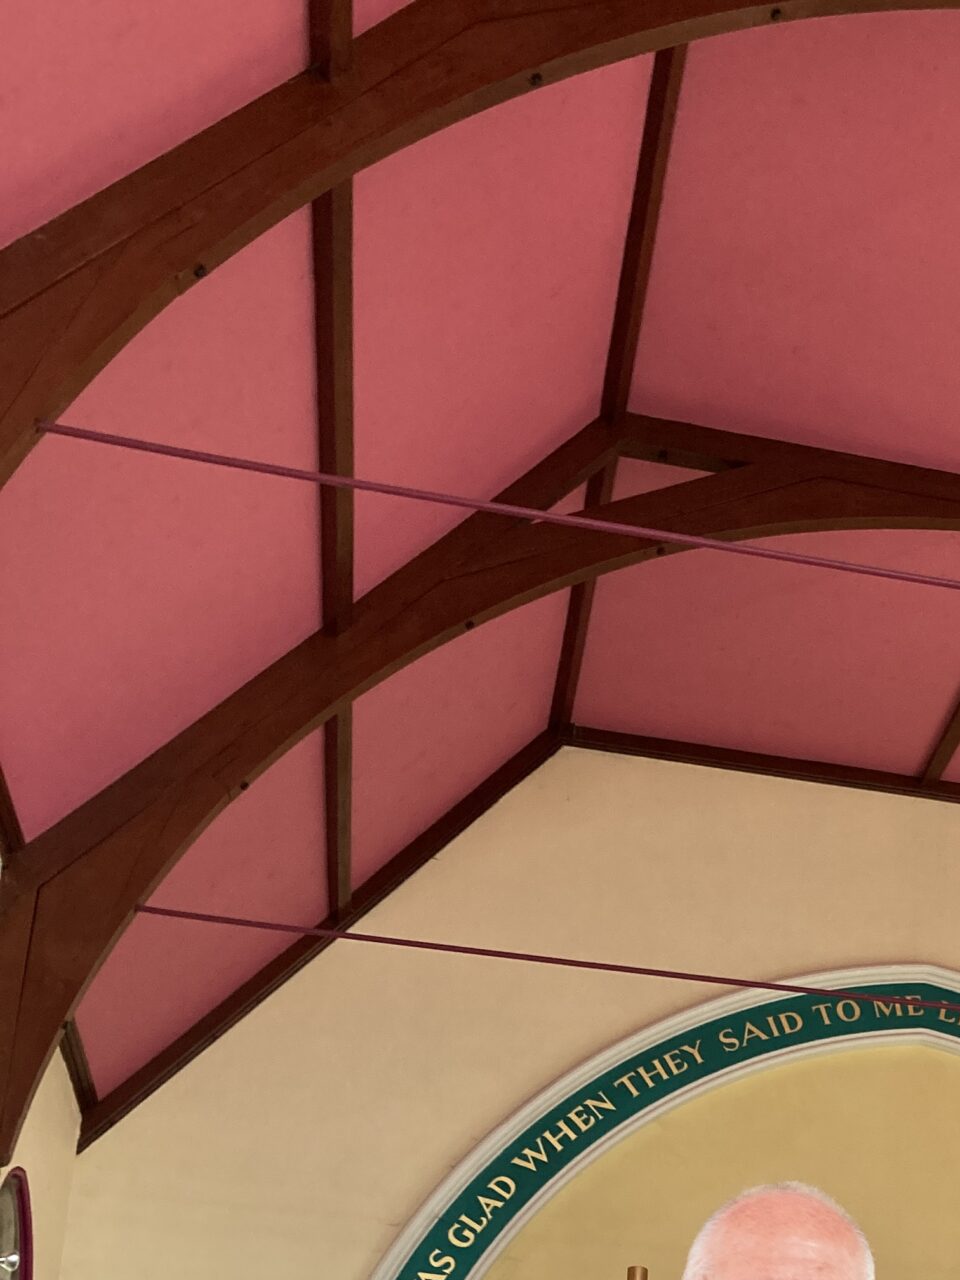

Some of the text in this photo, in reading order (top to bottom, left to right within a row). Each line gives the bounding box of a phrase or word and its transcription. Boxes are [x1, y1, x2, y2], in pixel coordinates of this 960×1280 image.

[447, 1176, 516, 1248] GLAD
[511, 1091, 616, 1172] WHEN
[613, 1040, 704, 1098] THEY
[719, 1011, 803, 1052] SAID
[811, 1000, 861, 1026] TO
[872, 995, 925, 1018] ME
